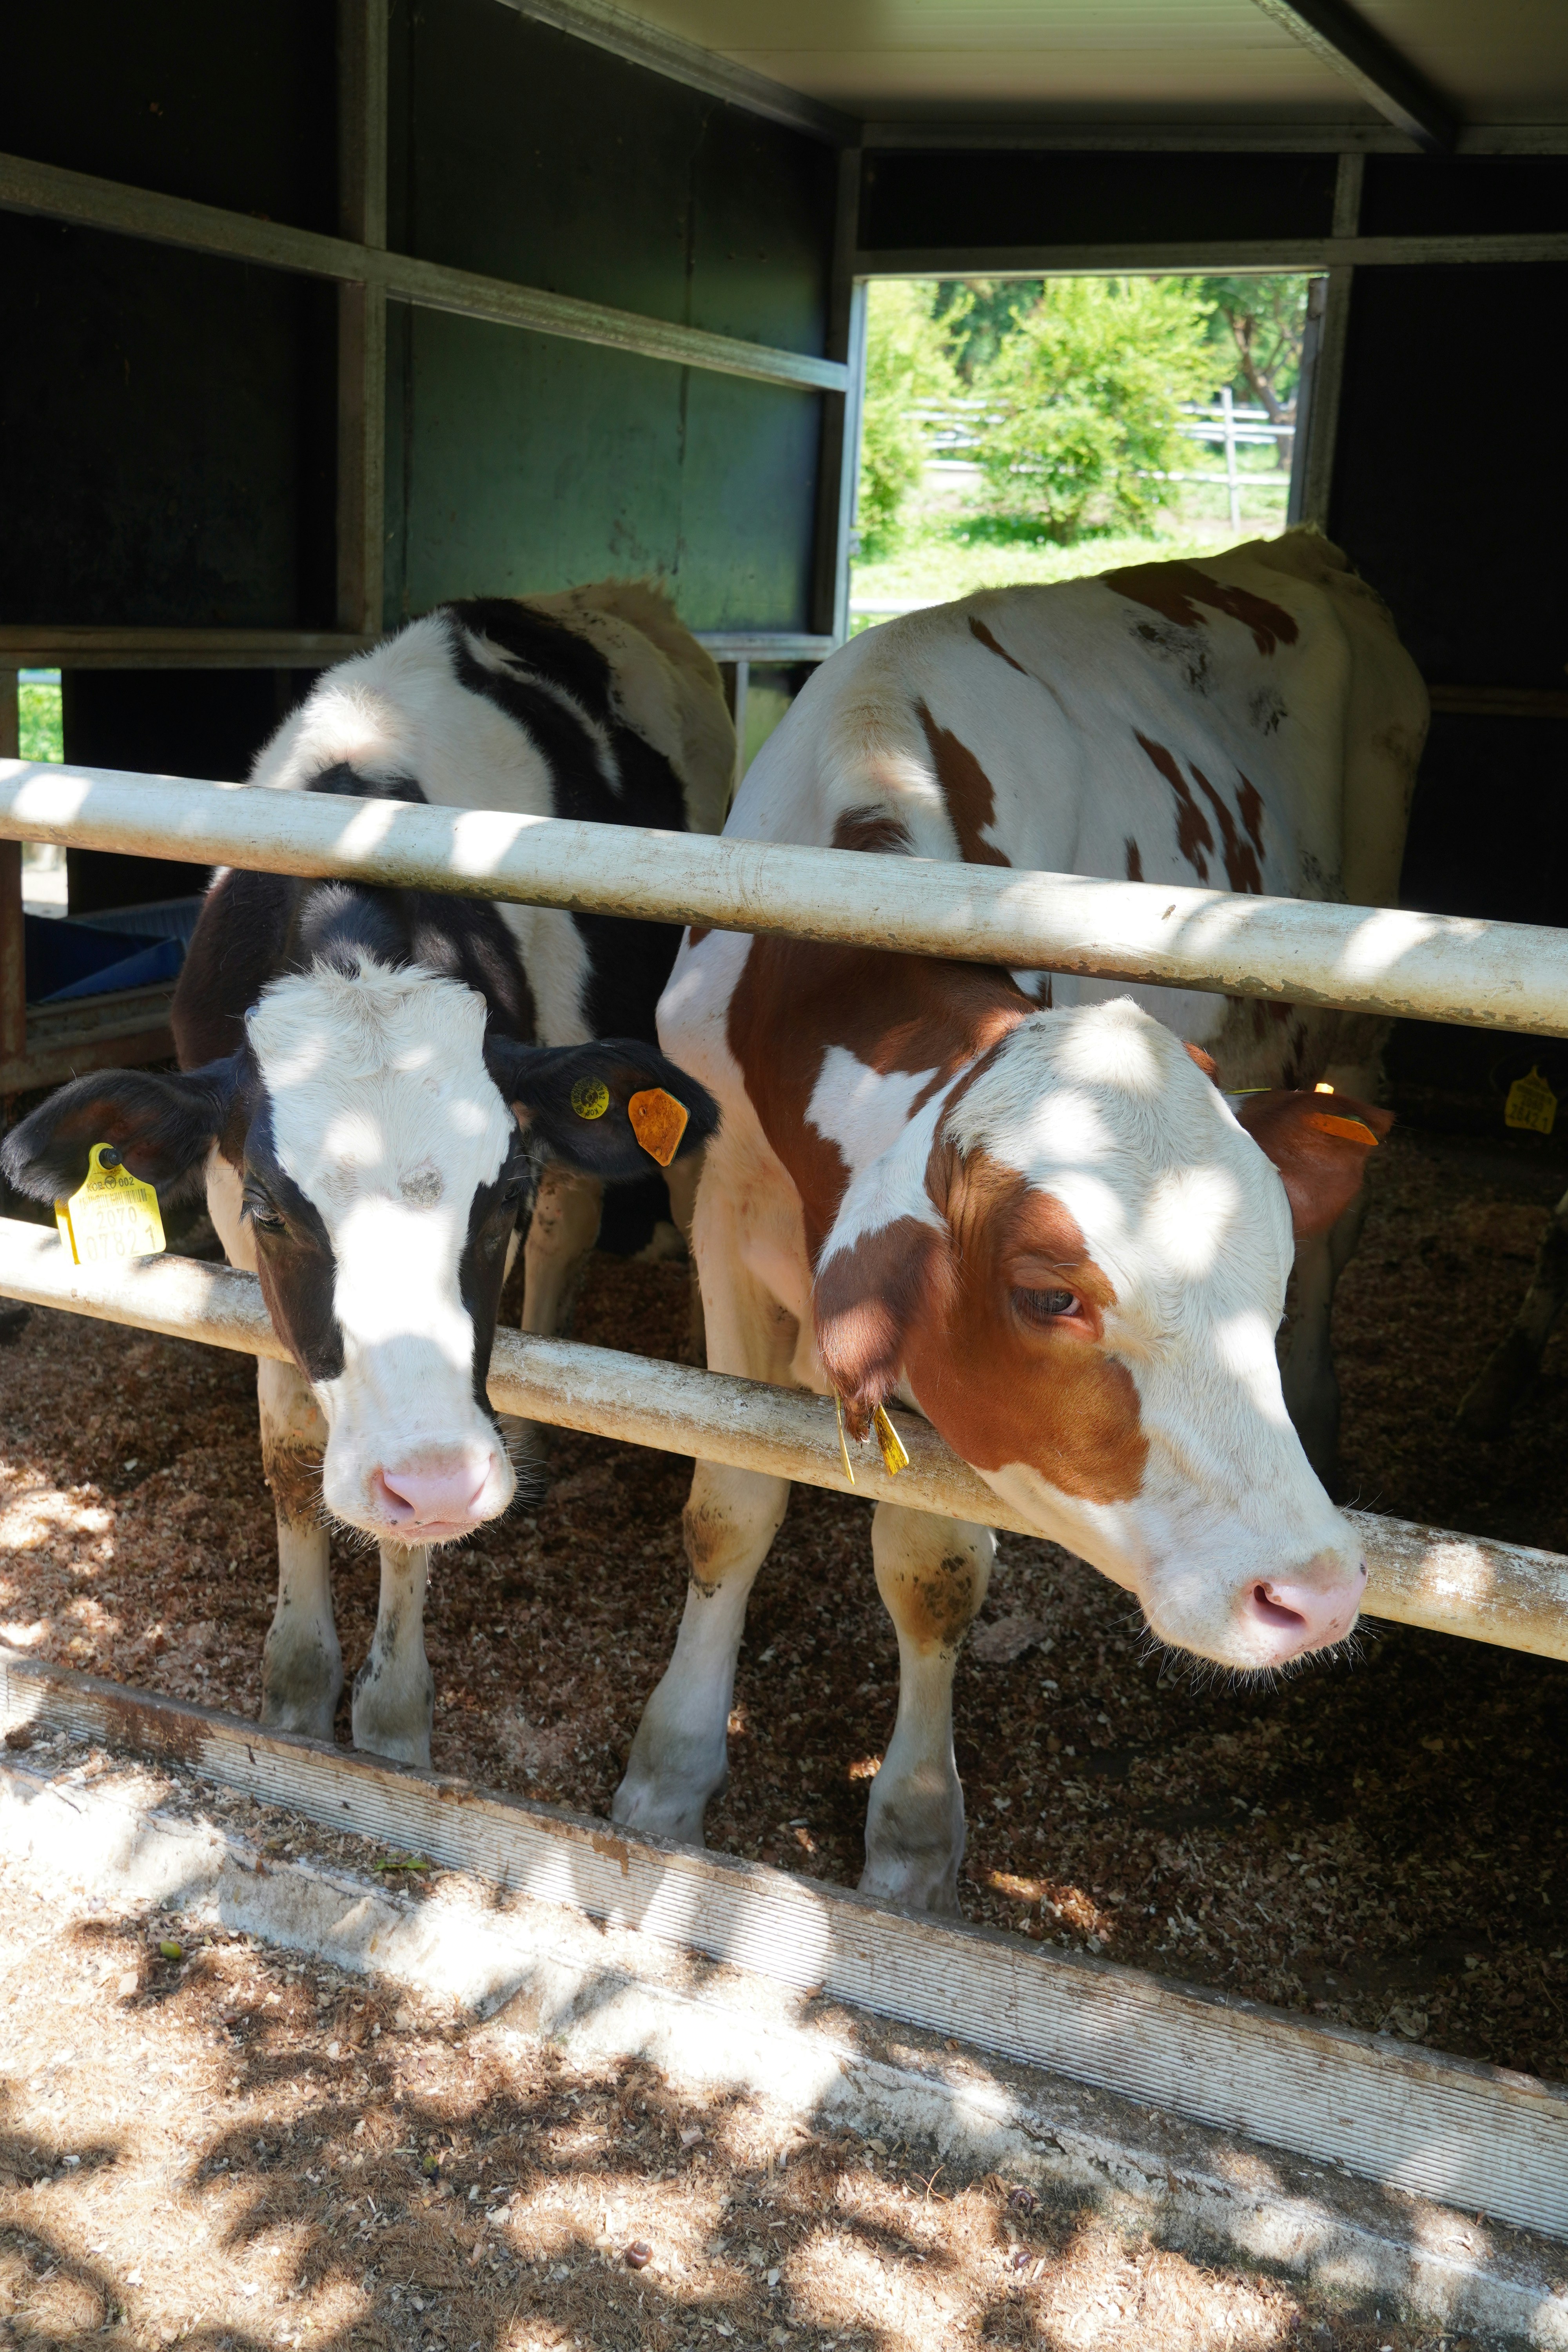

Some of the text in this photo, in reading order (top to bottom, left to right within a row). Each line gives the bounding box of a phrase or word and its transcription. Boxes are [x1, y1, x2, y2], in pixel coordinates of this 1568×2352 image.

[586, 1108, 599, 1116] KOR
[86, 1176, 135, 1192] KOR 002
[96, 1206, 137, 1230] 2070
[86, 1228, 140, 1261] 0782
